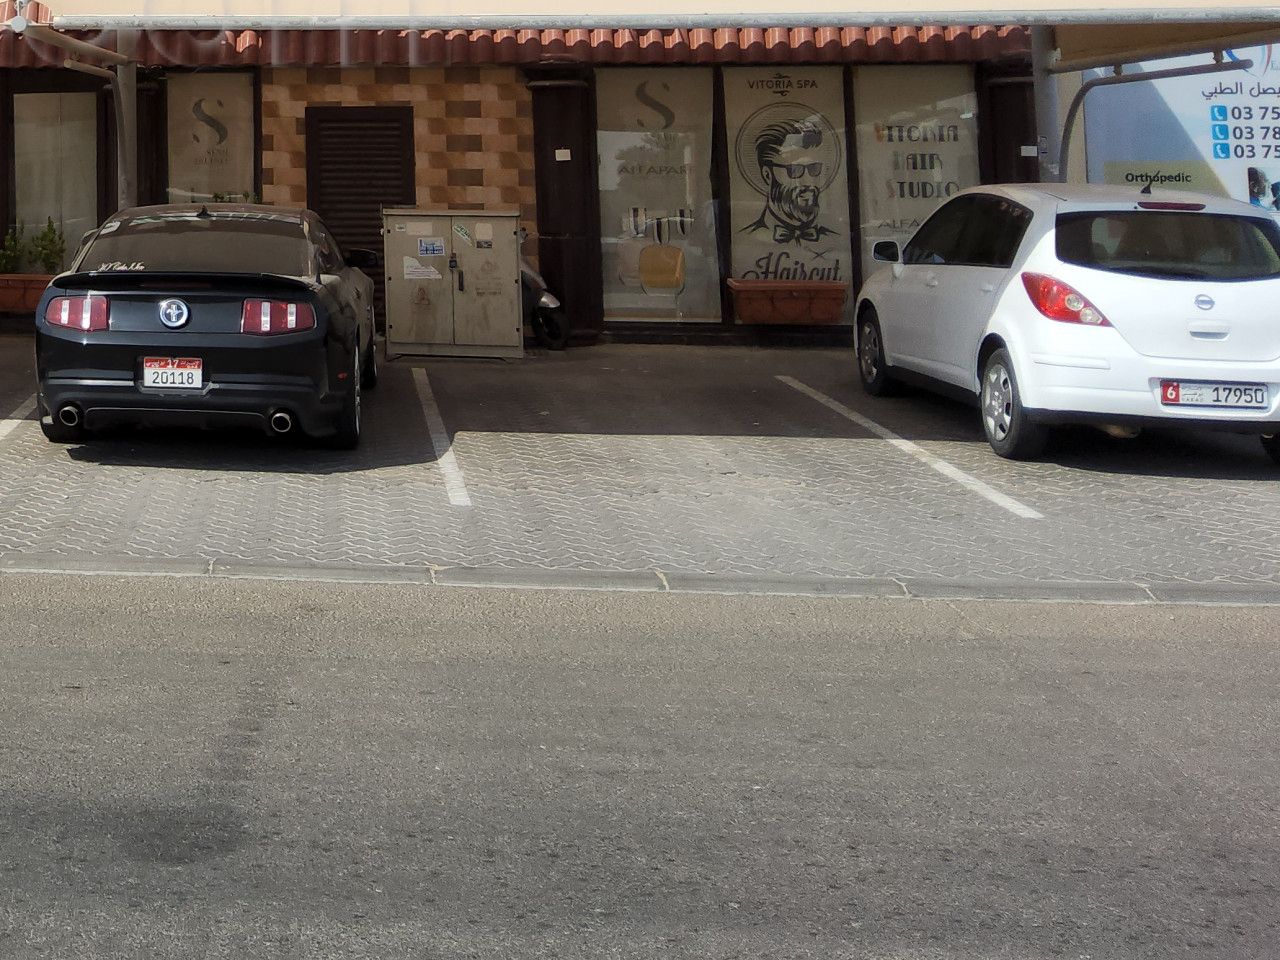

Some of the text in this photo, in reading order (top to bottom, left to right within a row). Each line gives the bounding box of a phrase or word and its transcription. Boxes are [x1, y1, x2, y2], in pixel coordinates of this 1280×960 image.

[747, 79, 818, 89] VITORIA SPA
[1201, 82, 1243, 100] الطبي
[1231, 106, 1253, 120] 03
[1232, 126, 1254, 140] 03
[1234, 144, 1256, 158] 03
[1125, 172, 1192, 184] Orthopedic
[878, 218, 920, 229] ALFA
[741, 251, 842, 281] Haircut
[166, 358, 179, 368] 17
[152, 371, 194, 385] 20118
[1166, 386, 1176, 399] 6
[1212, 387, 1265, 404] 17950
